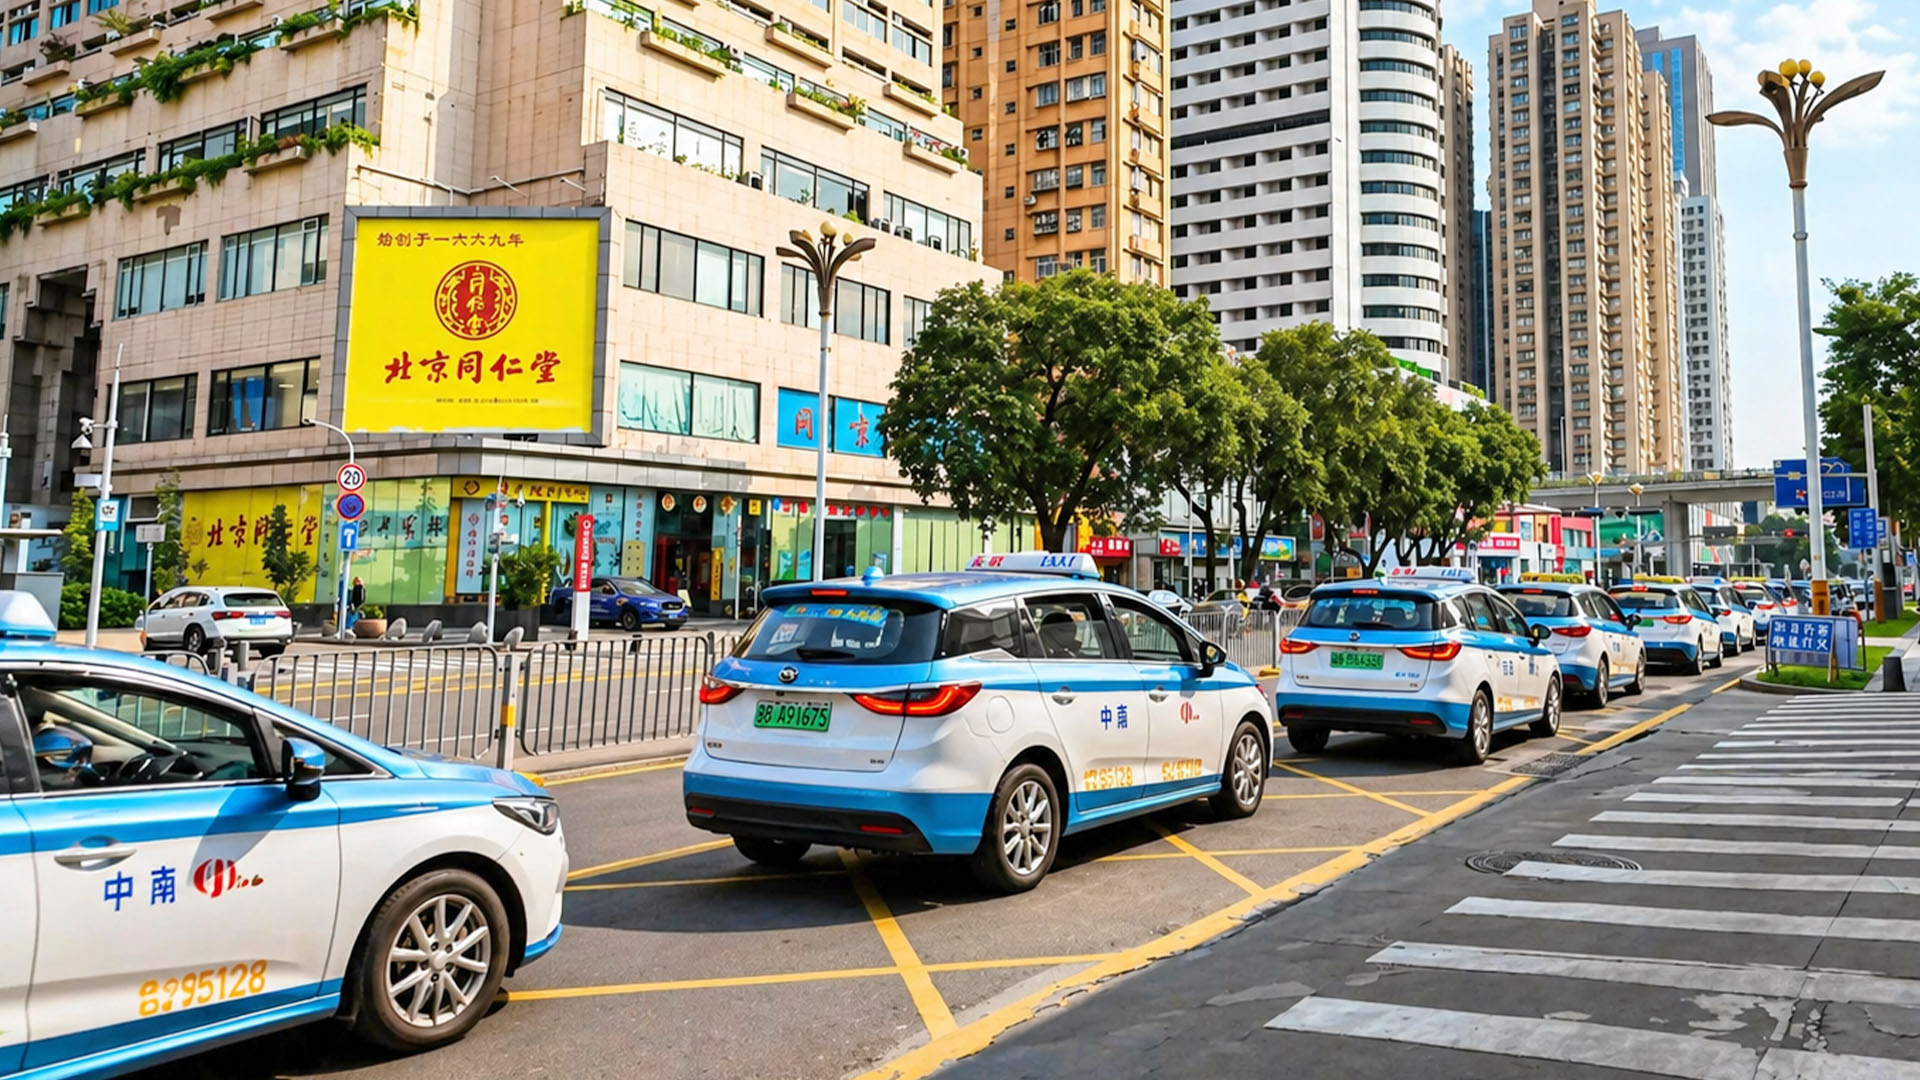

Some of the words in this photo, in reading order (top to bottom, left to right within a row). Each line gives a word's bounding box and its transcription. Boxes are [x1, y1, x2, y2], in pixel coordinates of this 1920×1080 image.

[377, 232, 524, 247] 始创于一六六九年
[384, 350, 561, 384] 北京同仁堂
[343, 470, 360, 485] 20
[104, 865, 176, 912] 中南
